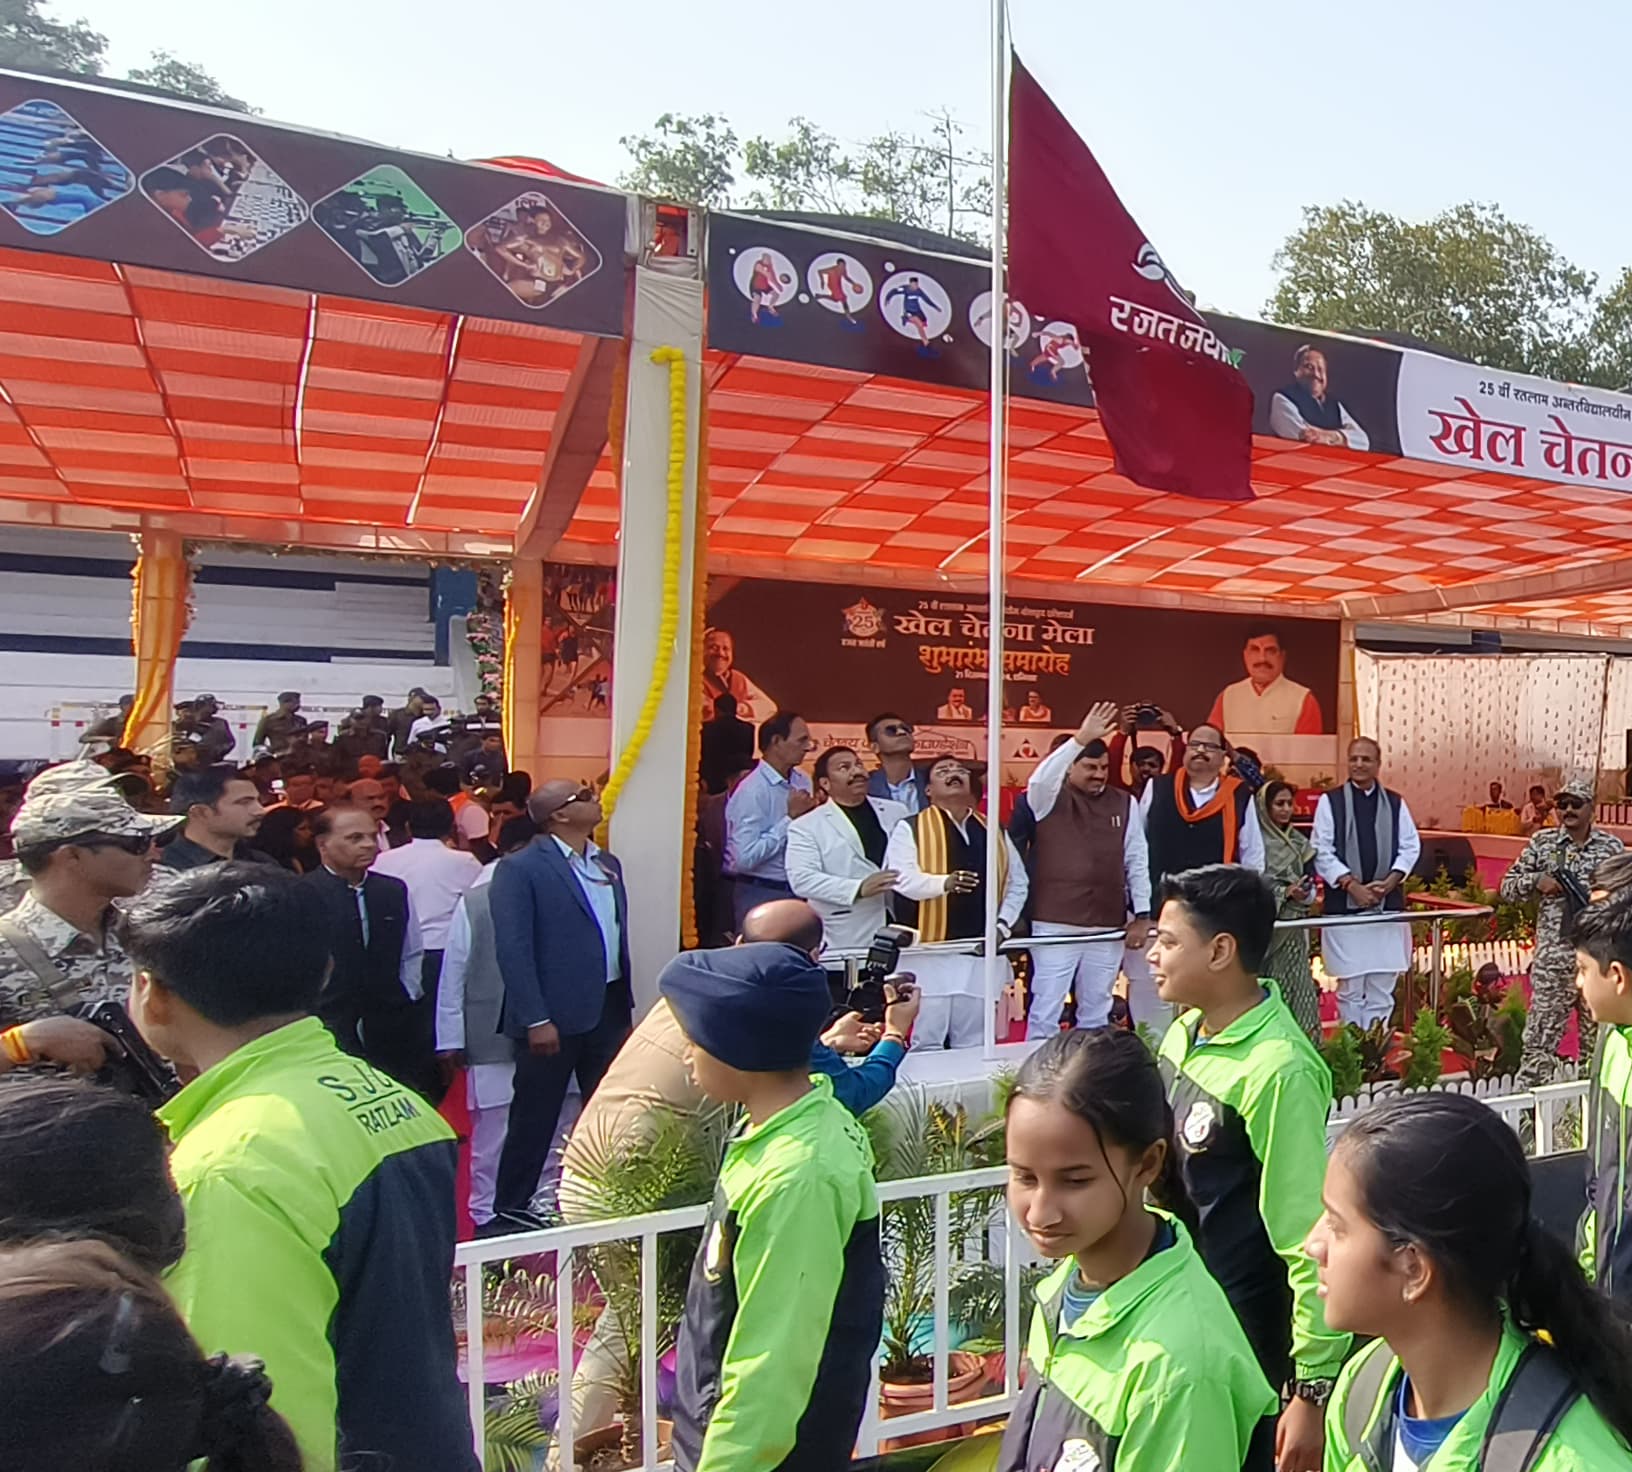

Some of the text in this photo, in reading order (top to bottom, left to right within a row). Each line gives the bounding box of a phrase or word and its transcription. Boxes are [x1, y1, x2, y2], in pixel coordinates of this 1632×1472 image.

[1109, 295, 1183, 344] रजत
[1479, 380, 1495, 396] 25
[1513, 388, 1549, 407] रतलाम
[1428, 396, 1526, 467] खेल
[852, 615, 874, 629] 25
[893, 610, 952, 637] खेल
[1041, 619, 1096, 645] मेला
[356, 1097, 422, 1136] RATLAM
